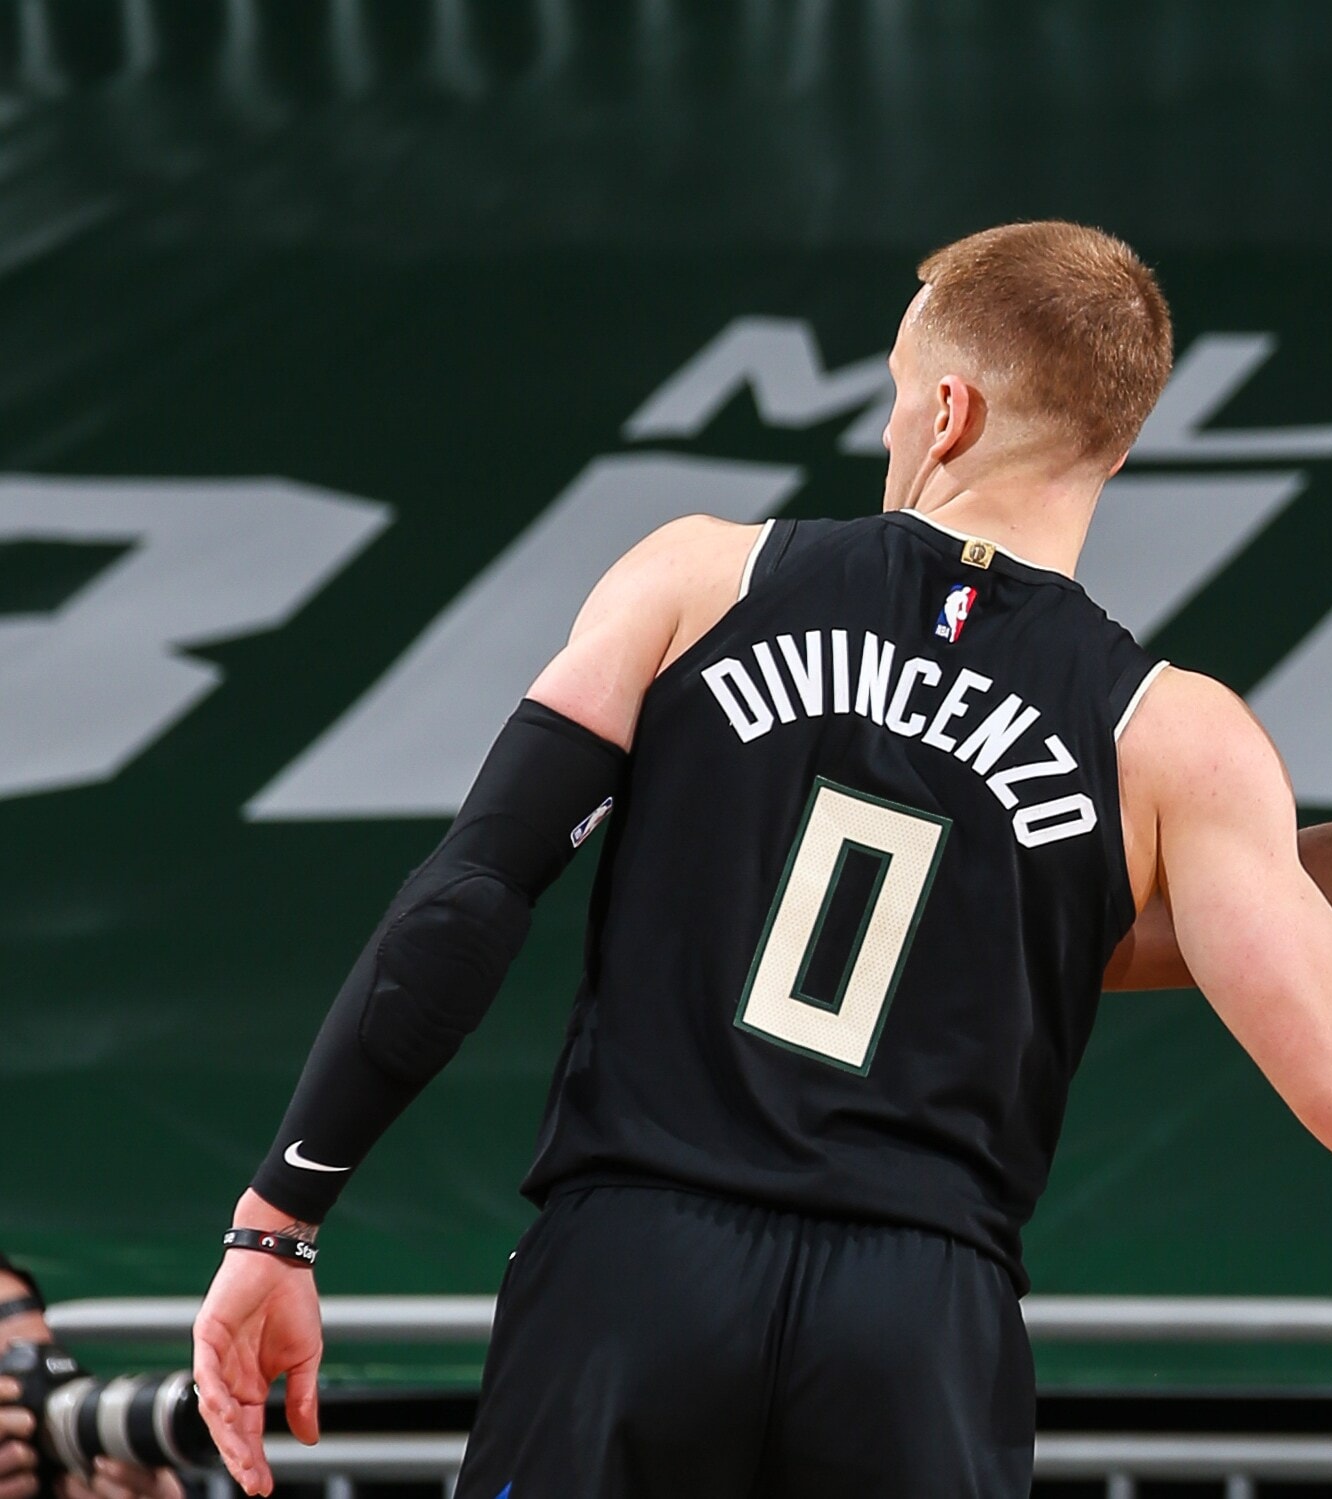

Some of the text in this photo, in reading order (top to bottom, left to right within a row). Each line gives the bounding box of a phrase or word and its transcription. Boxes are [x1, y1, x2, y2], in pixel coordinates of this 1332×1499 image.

[701, 629, 1097, 848] DIVINCENZO
[733, 776, 953, 1077] 0
[295, 1242, 319, 1264] Stay
